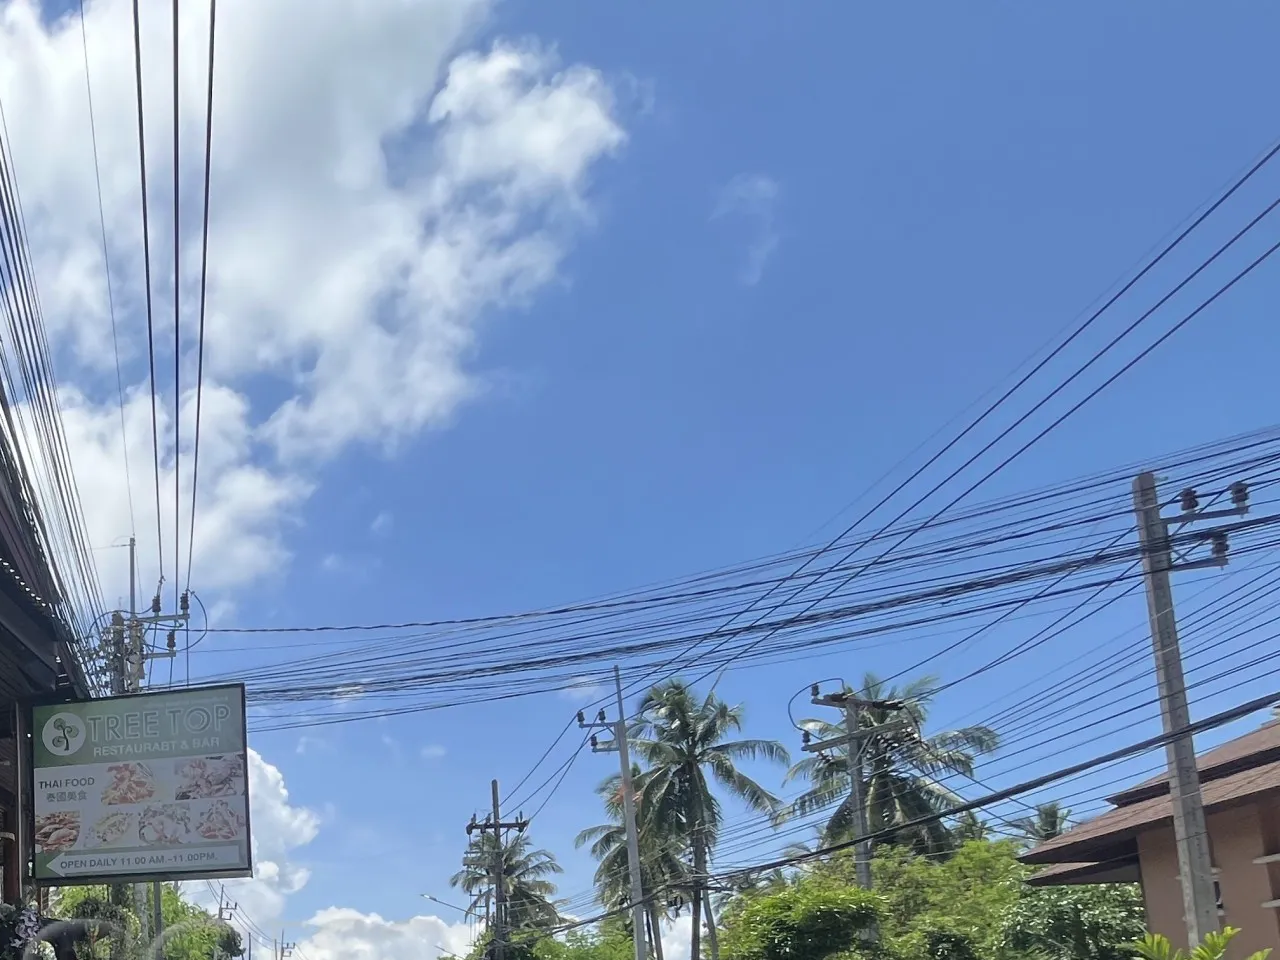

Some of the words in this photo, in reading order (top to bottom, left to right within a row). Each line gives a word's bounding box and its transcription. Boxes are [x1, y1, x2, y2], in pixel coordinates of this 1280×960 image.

[86, 711, 160, 742] TREE
[165, 704, 231, 736] TOP
[180, 740, 190, 750] &
[192, 736, 220, 748] BAR
[38, 779, 62, 790] THAI
[65, 776, 95, 788] FOOD
[60, 859, 87, 870] OPEN
[89, 857, 117, 869] DAILY
[120, 856, 146, 866] 11.00
